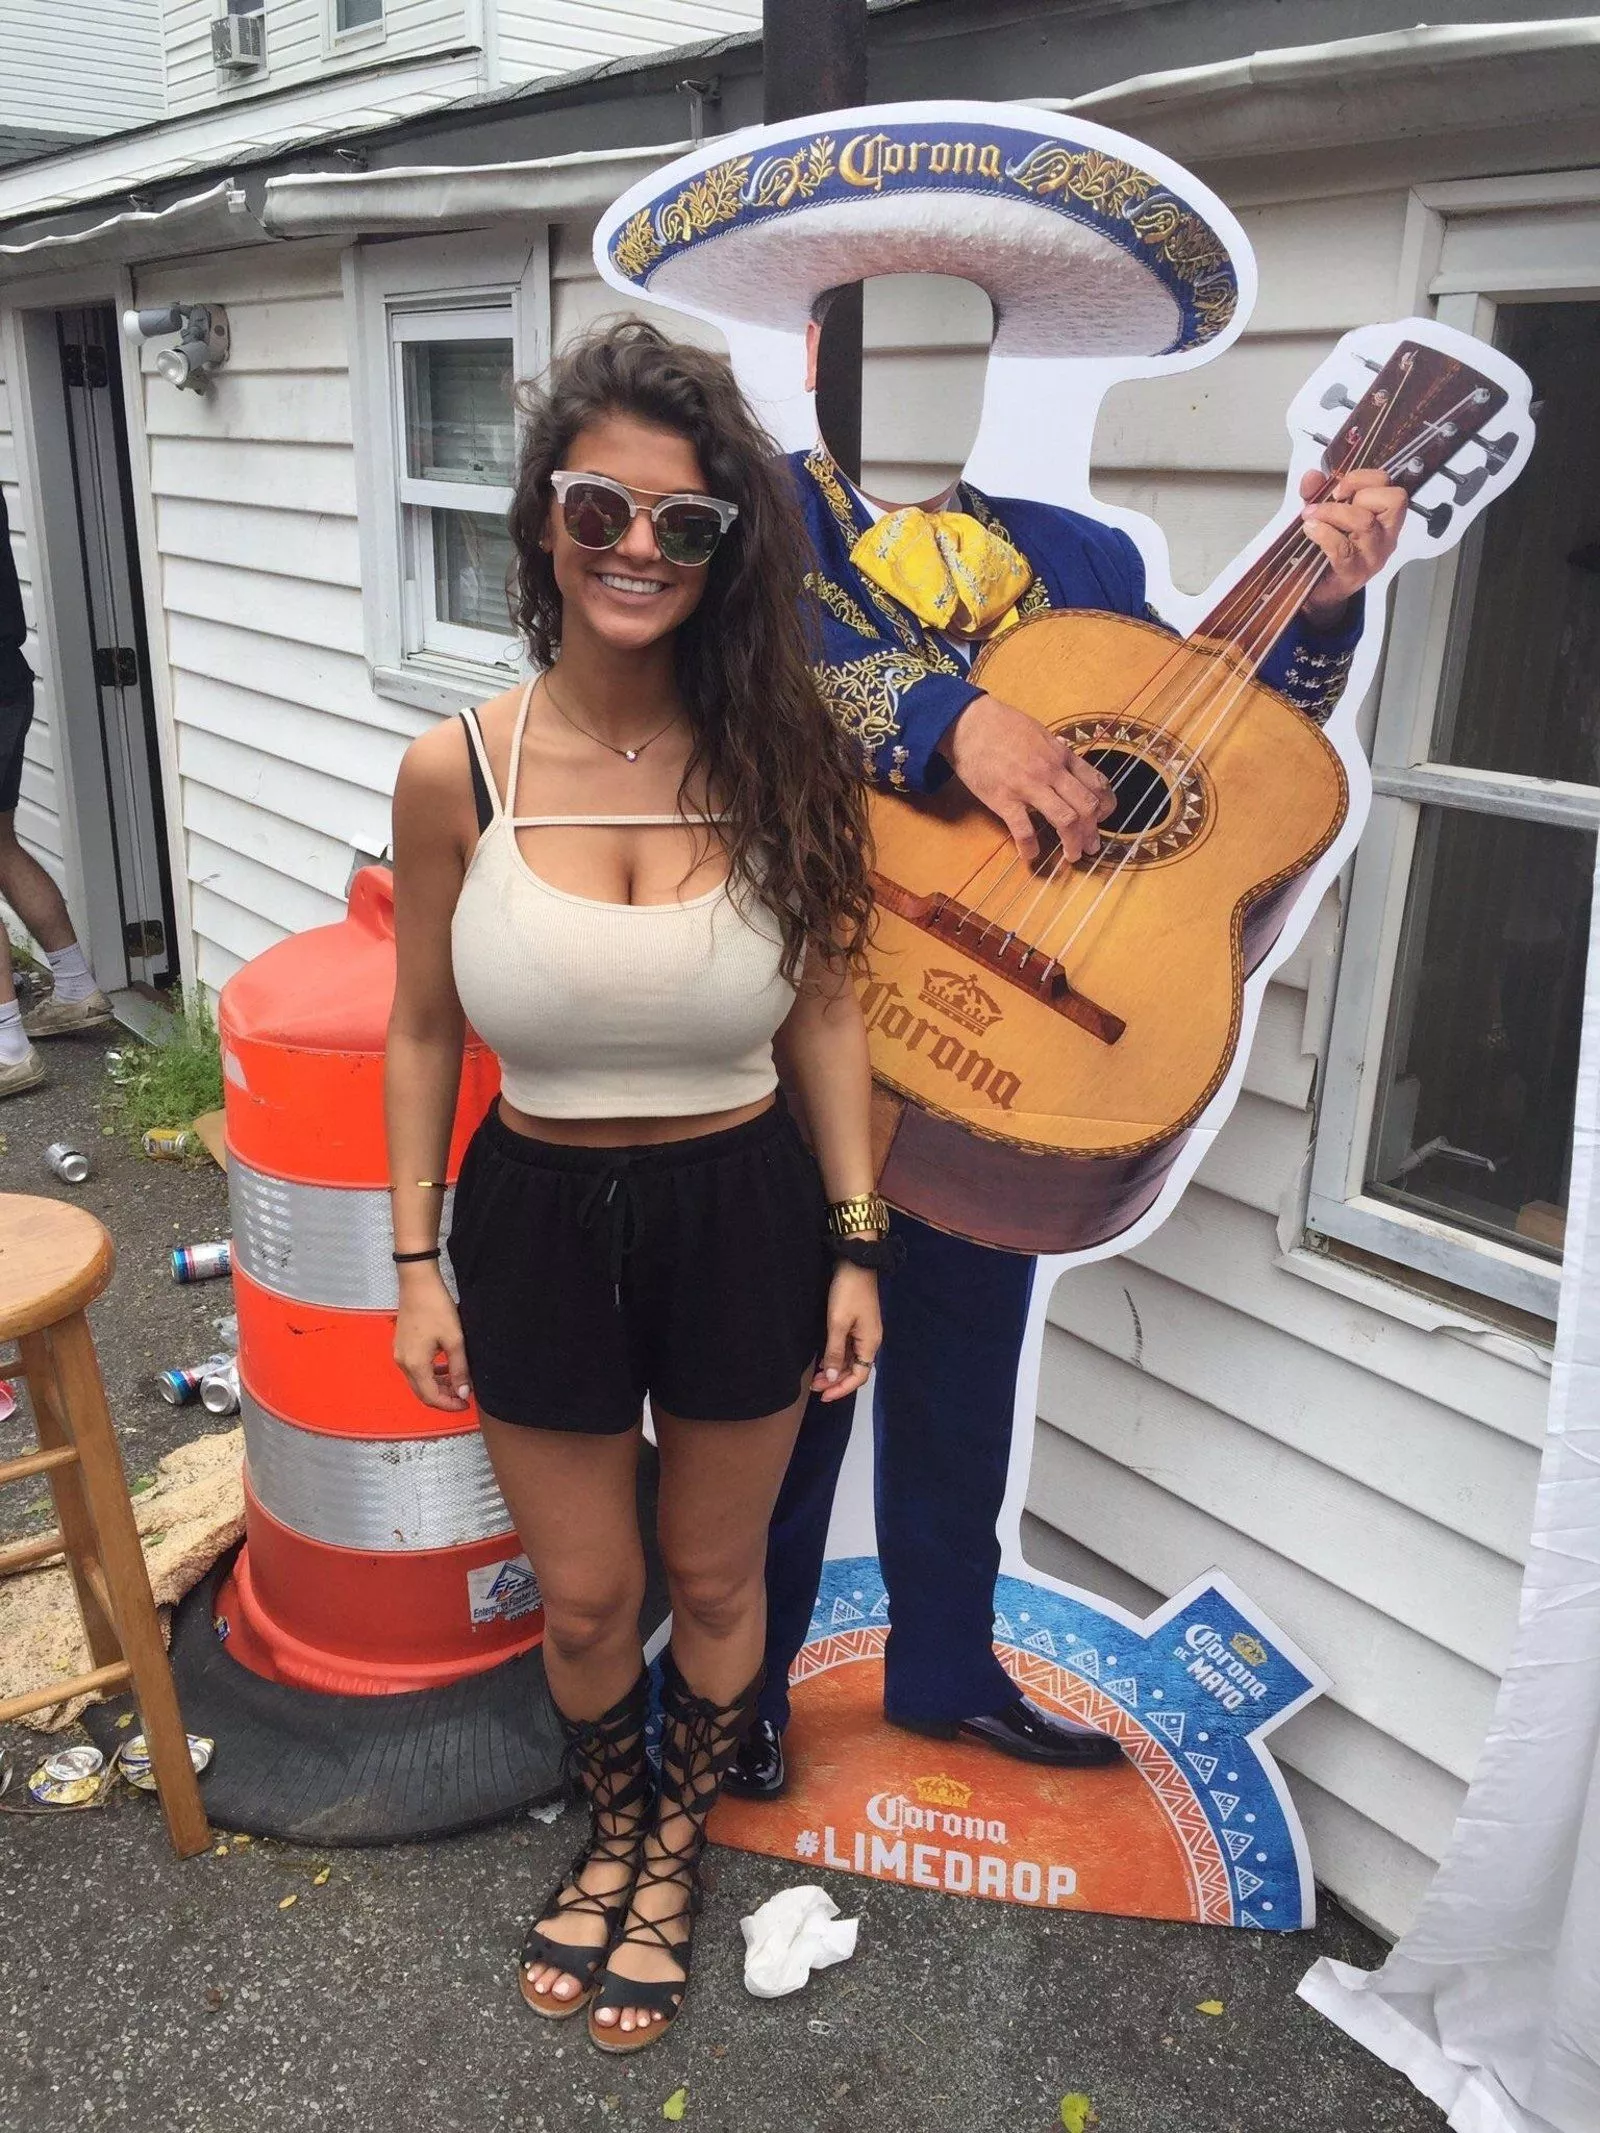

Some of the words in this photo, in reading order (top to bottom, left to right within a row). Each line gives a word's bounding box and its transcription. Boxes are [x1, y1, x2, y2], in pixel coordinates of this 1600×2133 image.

[839, 132, 1004, 191] Corona
[1185, 1624, 1268, 1700] Corona
[1186, 1656, 1245, 1710] MAYO
[866, 1792, 1009, 1845] Corona
[794, 1825, 1077, 1905] #LIMEDROP
